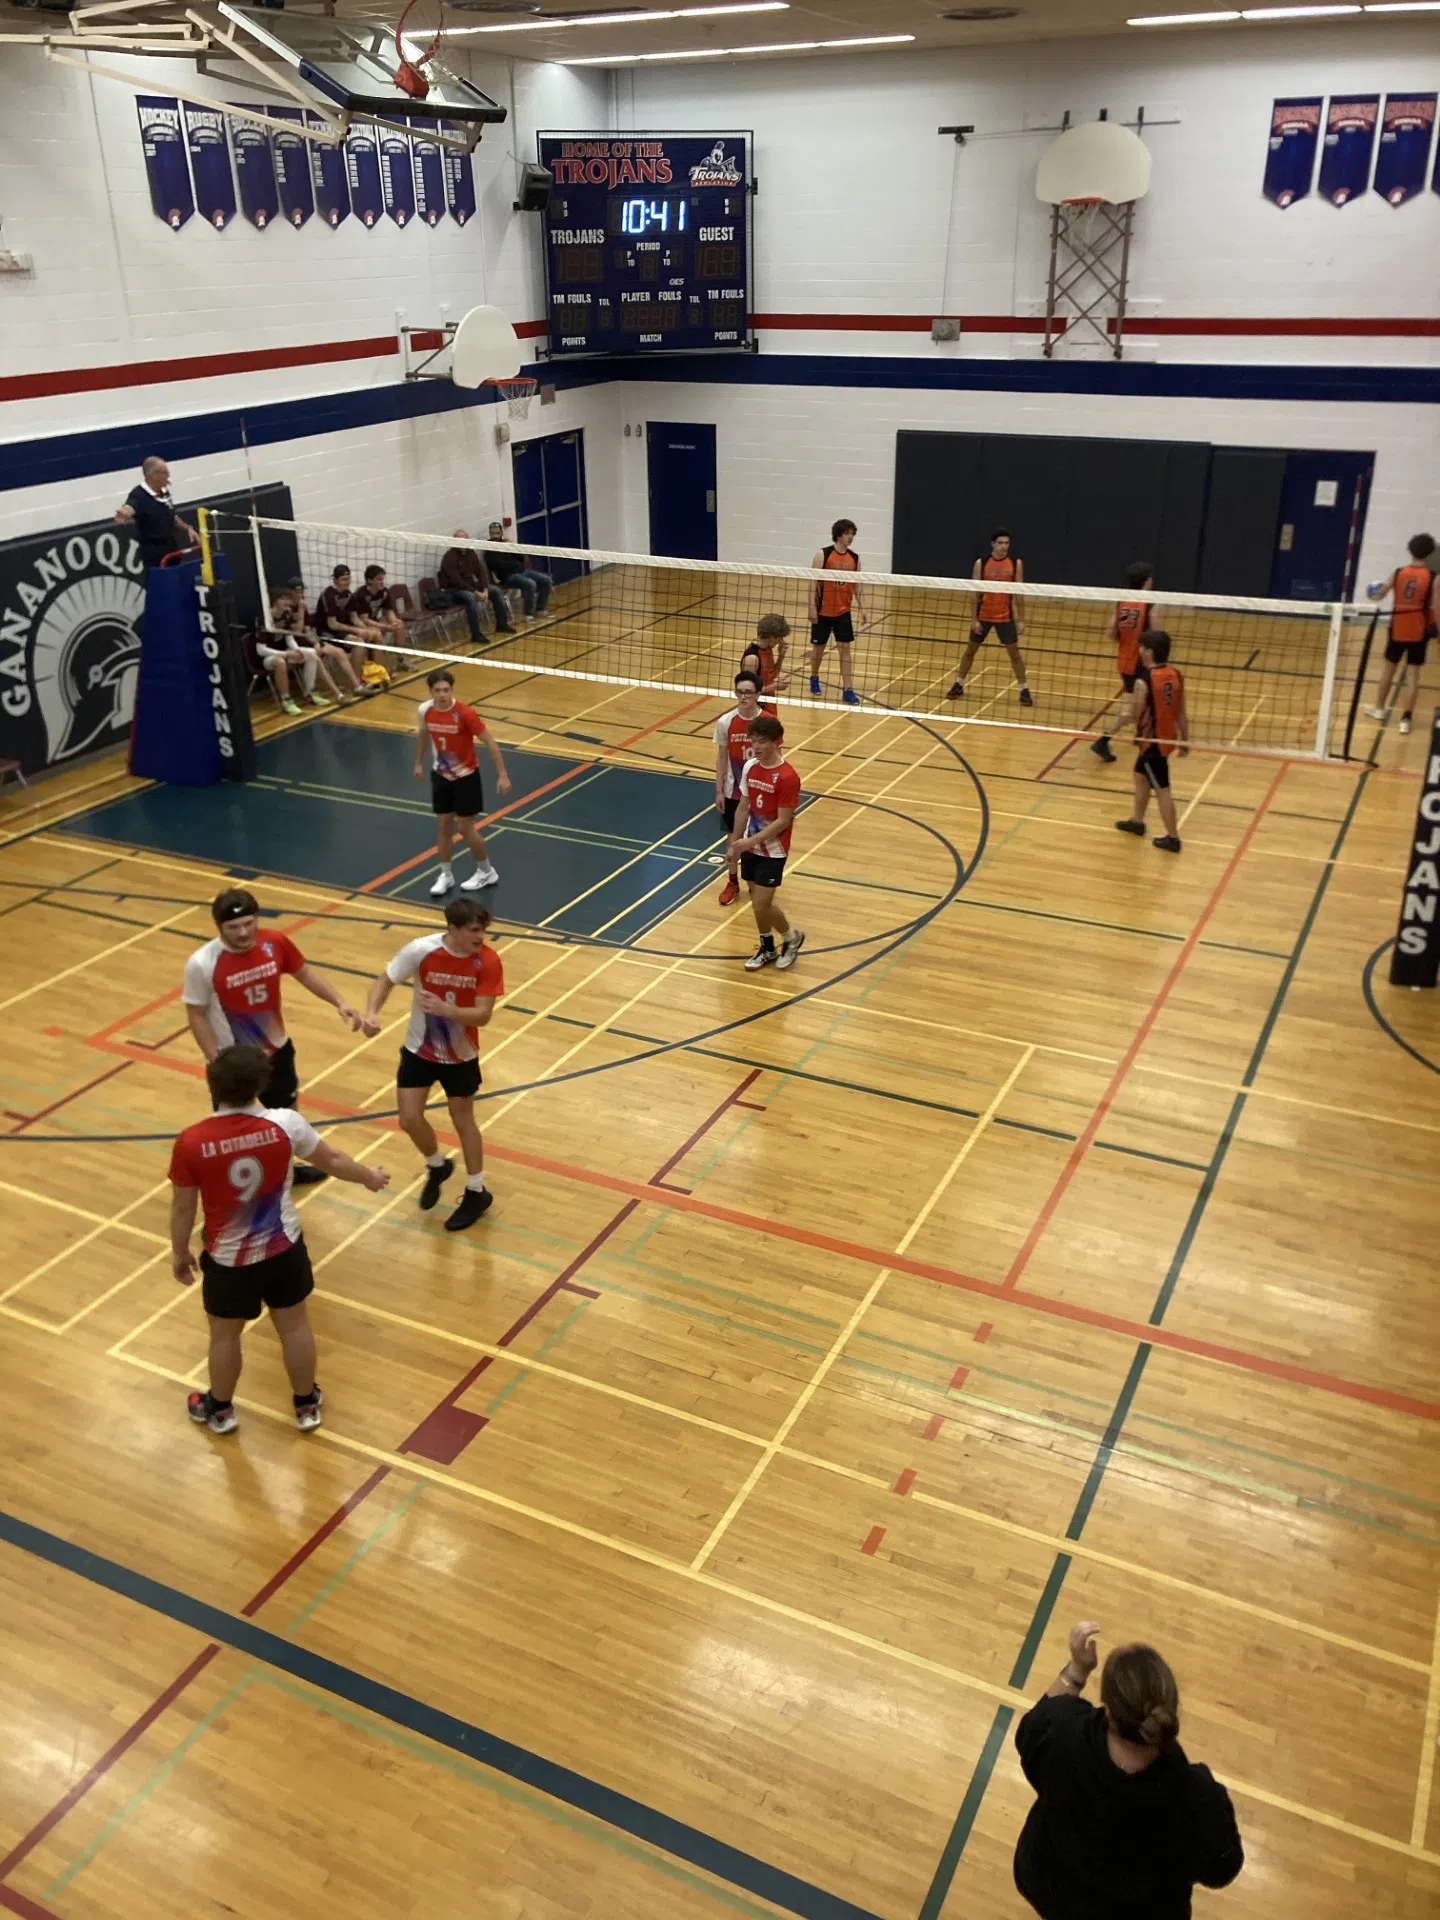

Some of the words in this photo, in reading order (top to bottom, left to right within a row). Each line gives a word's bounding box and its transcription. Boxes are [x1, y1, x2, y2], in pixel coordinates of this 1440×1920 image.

[187, 111, 222, 132] RUGBY
[561, 142, 609, 158] HOME
[612, 142, 632, 157] OF
[634, 142, 664, 157] THE
[551, 158, 673, 190] TROJANS
[689, 166, 742, 183] TROJANS
[622, 200, 687, 233] 10:41
[550, 229, 605, 245] TROJANS
[699, 227, 735, 241] GUEST
[636, 242, 661, 251] PERIOD
[552, 294, 565, 304] TM
[567, 293, 592, 304] FOULS
[621, 292, 650, 302] PLAYER
[658, 291, 682, 301] FOULS
[707, 289, 719, 299] TM
[721, 288, 744, 299] FOULS
[561, 336, 586, 346] POINTS
[639, 334, 662, 343] MATCH
[714, 331, 738, 341] POINTS
[0, 533, 144, 717] GANANOQU
[195, 585, 234, 758] TROJANS
[740, 745, 755, 761] 10
[755, 794, 764, 809] 6
[1399, 719, 1440, 954] OJANS
[244, 983, 268, 1006] 15
[201, 1141, 217, 1158] LA
[229, 1155, 263, 1202] 9
